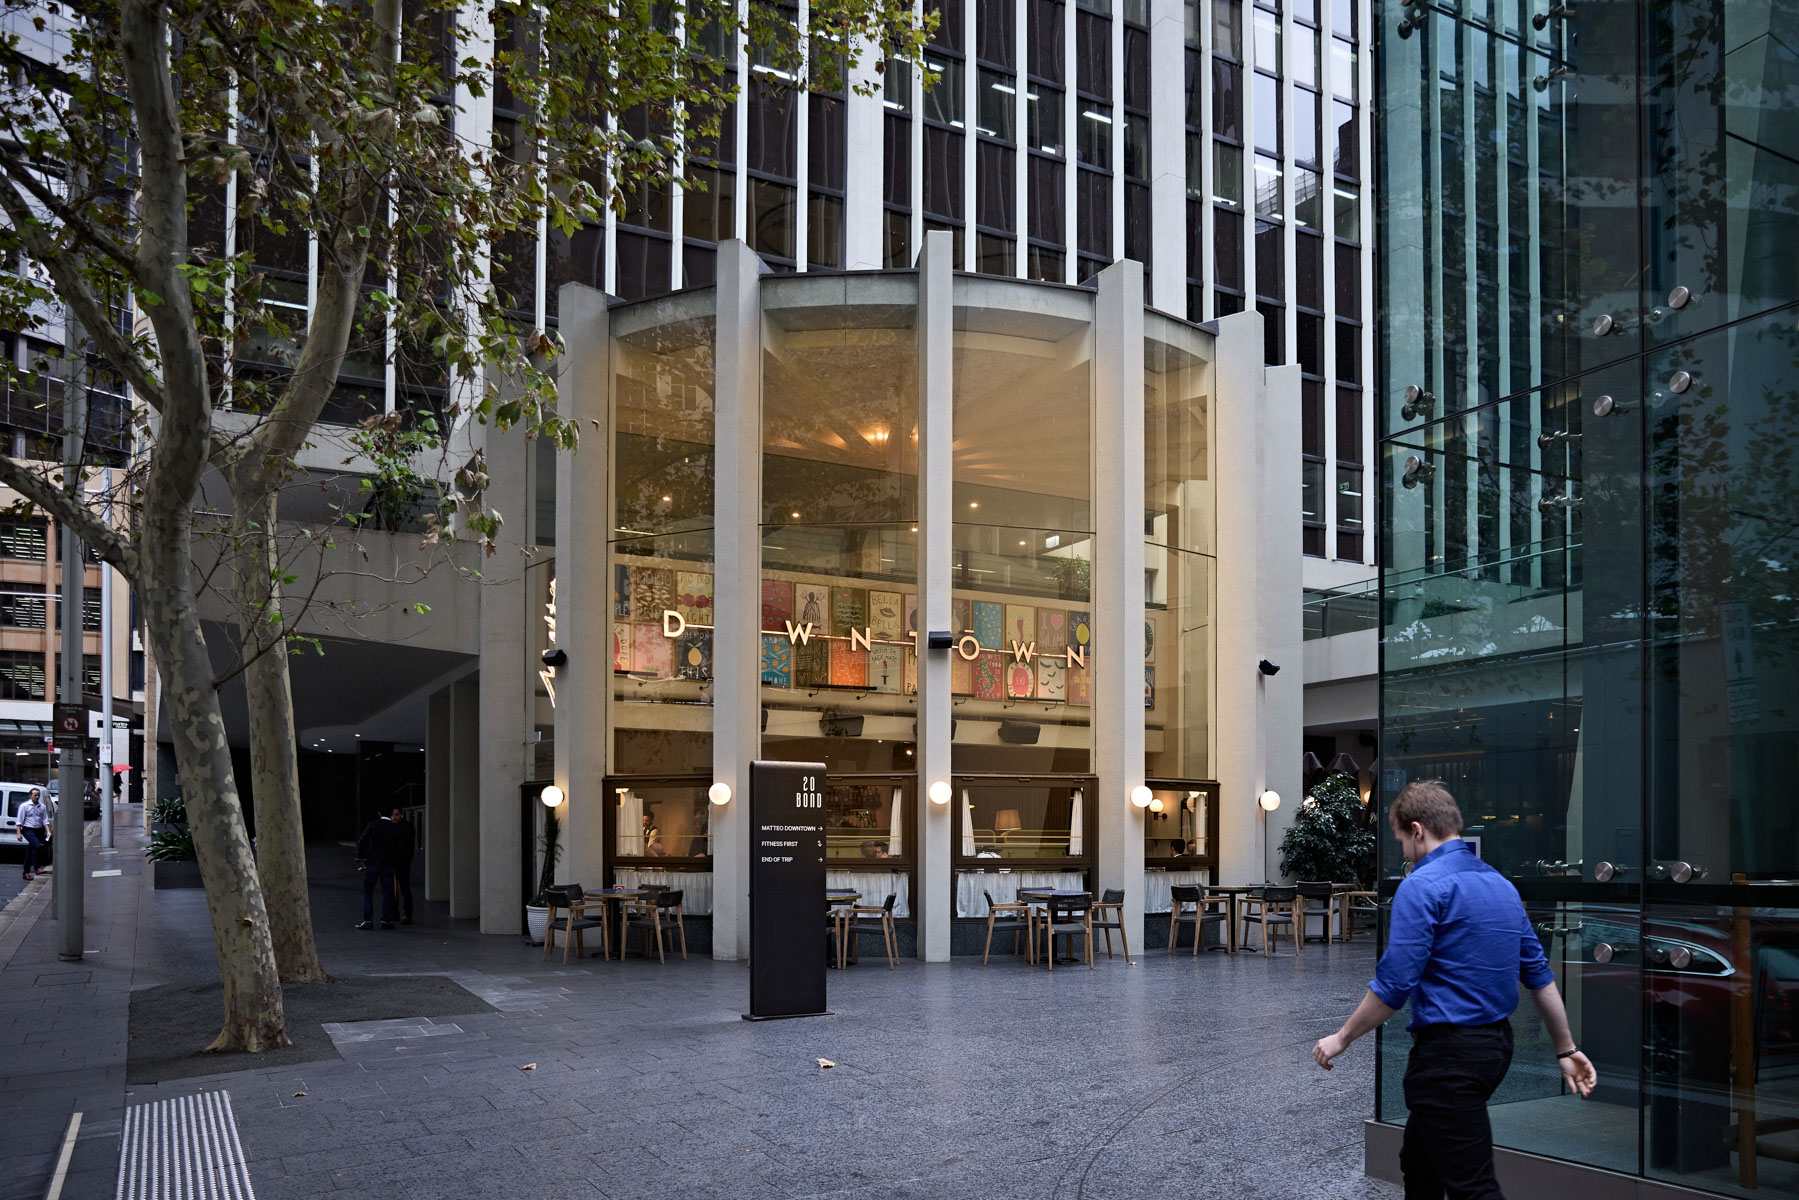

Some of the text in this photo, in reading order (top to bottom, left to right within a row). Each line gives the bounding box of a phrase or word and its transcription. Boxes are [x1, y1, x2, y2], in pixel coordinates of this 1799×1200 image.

[871, 595, 899, 606] BELLA
[683, 612, 710, 625] IGHT
[871, 616, 900, 630] BELLA
[802, 776, 815, 792] 20
[796, 792, 822, 809] BOND
